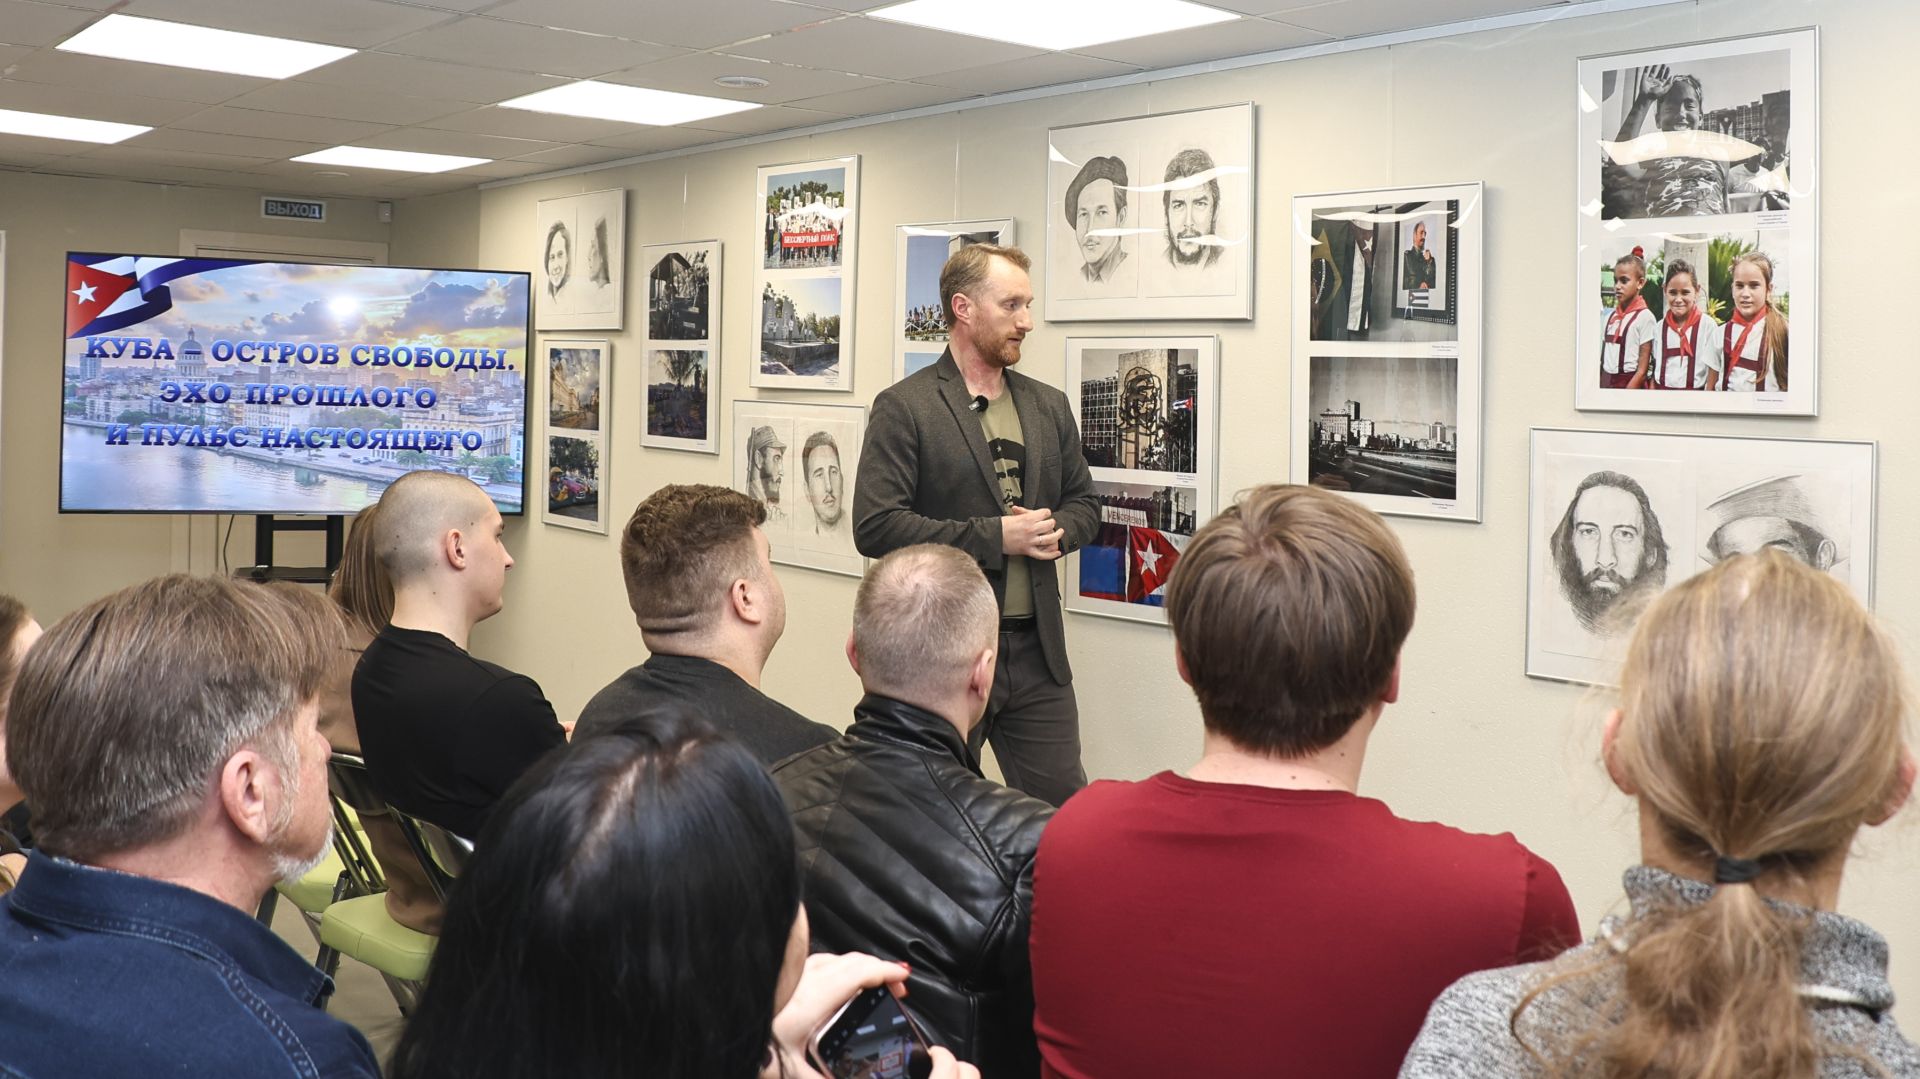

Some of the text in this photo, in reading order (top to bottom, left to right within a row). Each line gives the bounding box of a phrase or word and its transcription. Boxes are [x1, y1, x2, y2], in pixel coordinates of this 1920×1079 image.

[267, 202, 320, 218] ВЫХОД
[85, 336, 175, 360] КУБА
[211, 339, 340, 365] ОСТРОВ
[351, 344, 515, 372] СВОБОДЫ.
[160, 381, 437, 409] ЭХО ПРОШЛОГО
[105, 424, 483, 453] И ПУЛЬС НАСТОЯЩЕГО
